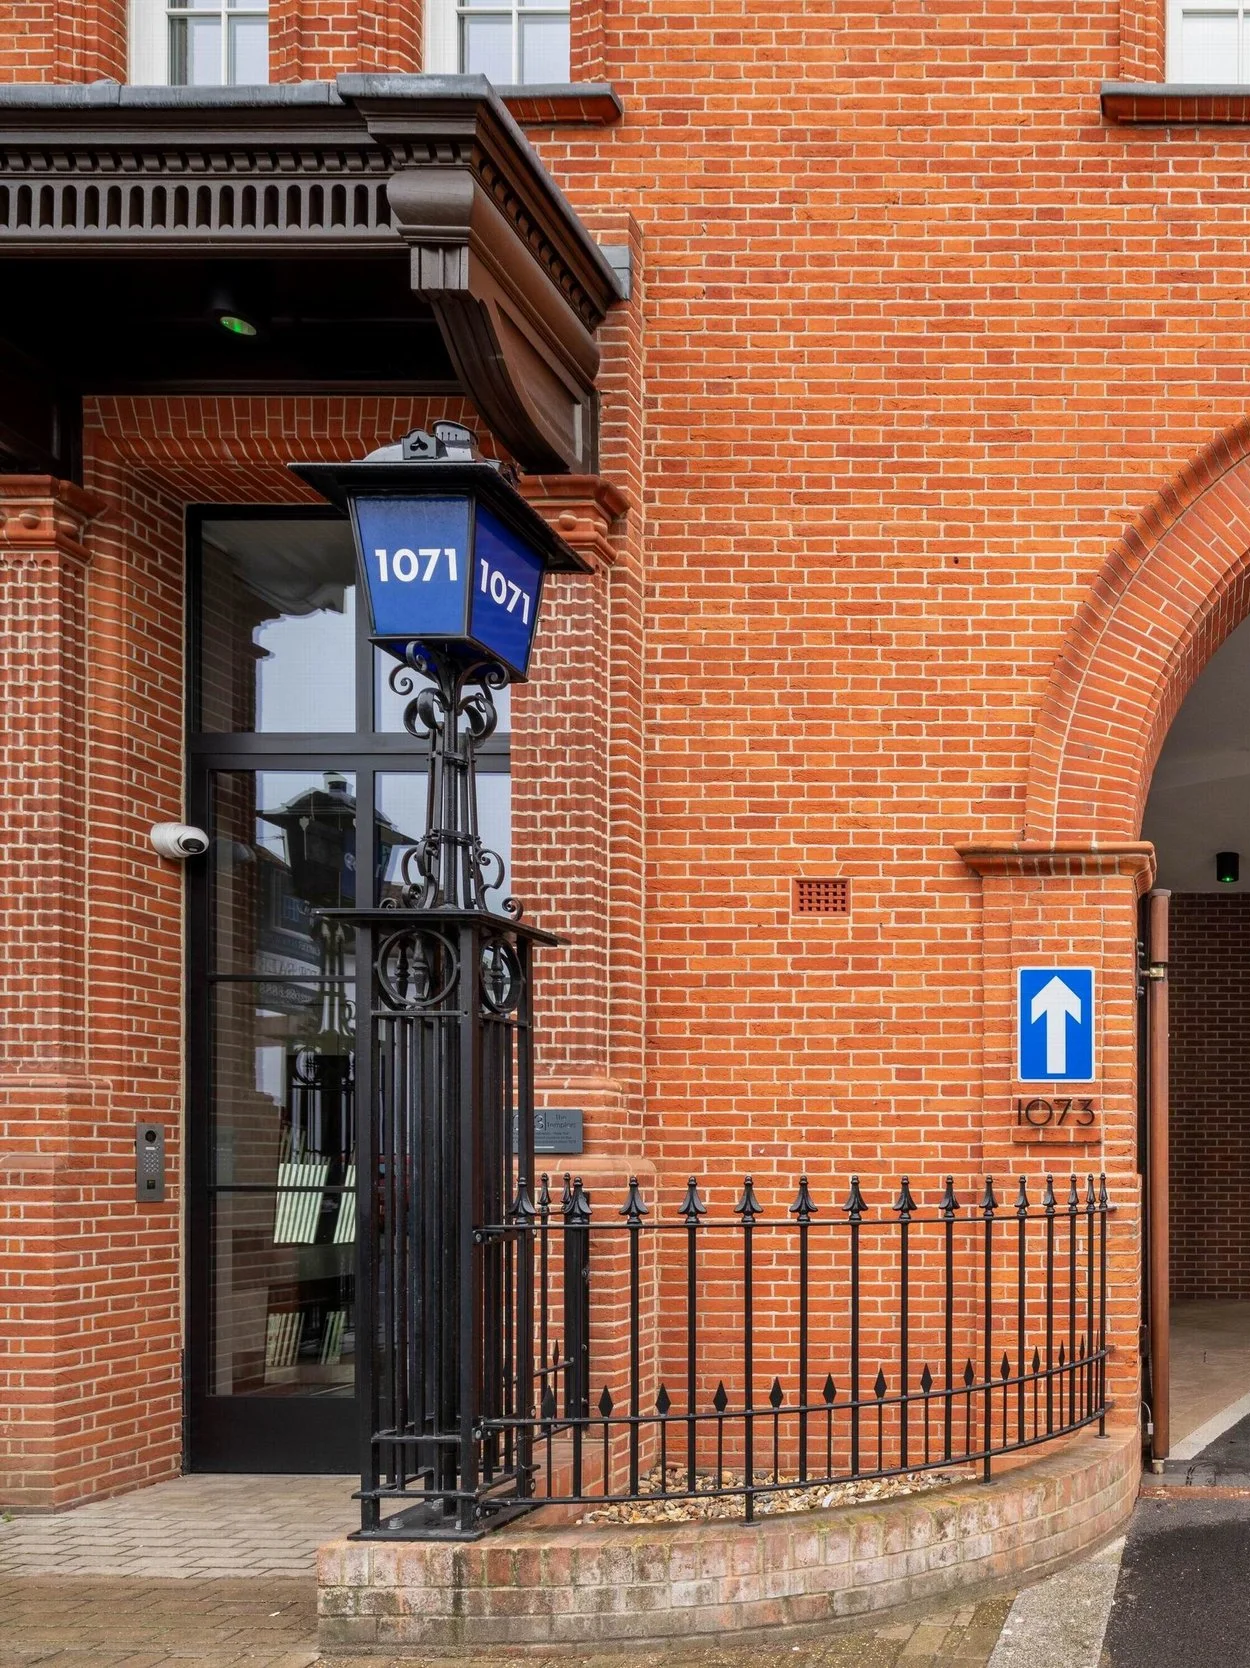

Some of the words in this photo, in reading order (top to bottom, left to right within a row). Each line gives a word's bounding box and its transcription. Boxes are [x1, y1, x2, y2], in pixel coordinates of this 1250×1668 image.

[374, 548, 458, 582] 1071
[480, 558, 530, 625] 1071
[1017, 1098, 1095, 1127] 1073
